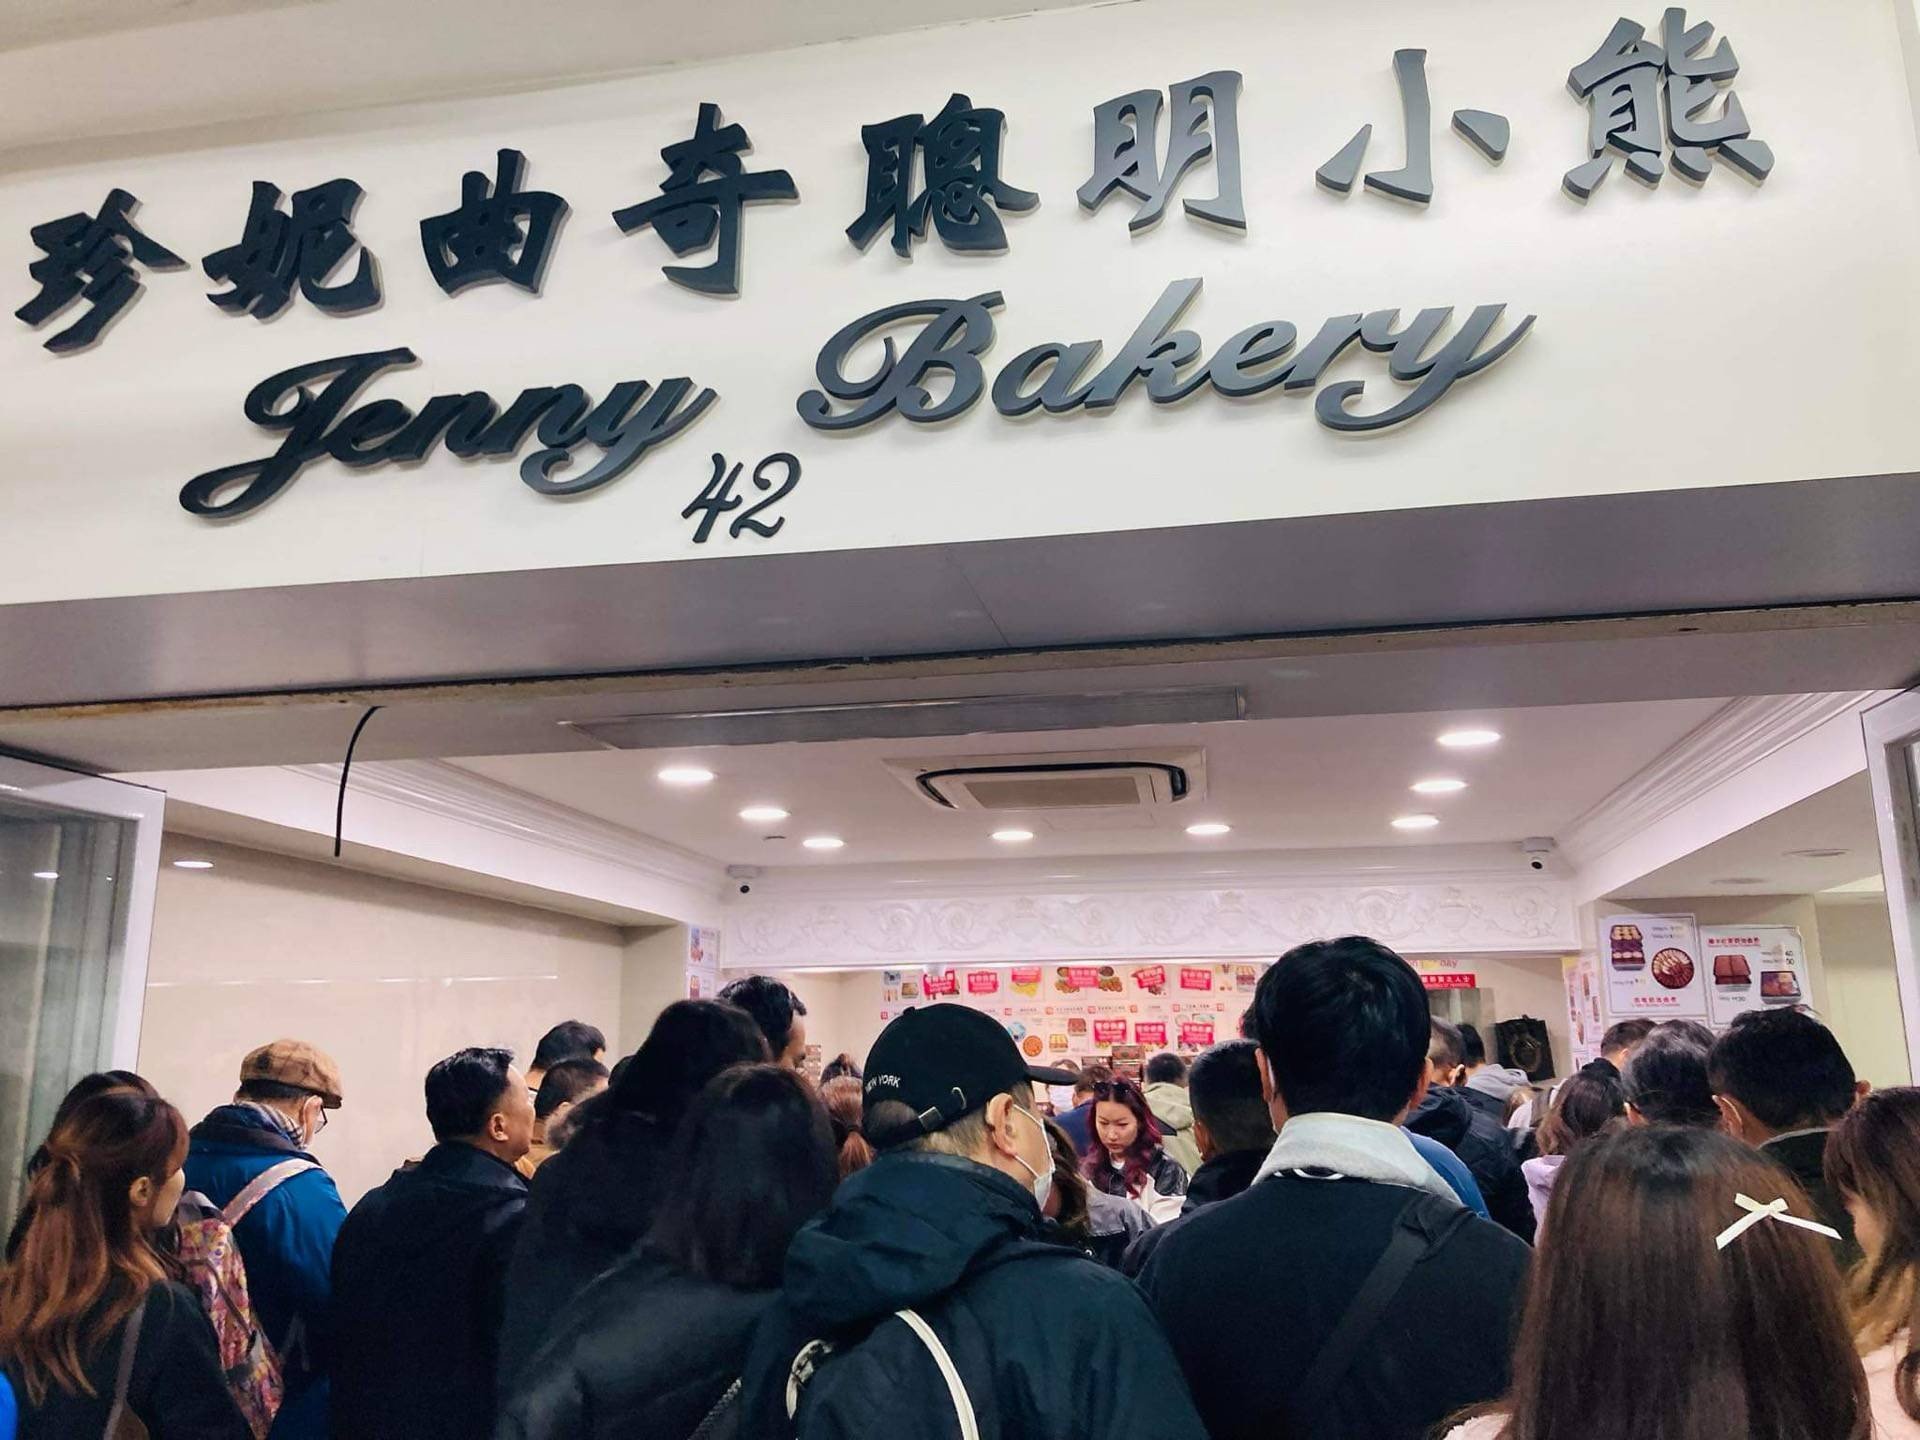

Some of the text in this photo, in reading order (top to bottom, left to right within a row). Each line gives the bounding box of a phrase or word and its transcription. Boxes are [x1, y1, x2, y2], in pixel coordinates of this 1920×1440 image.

[14, 7, 1775, 356] 珍妮曲奇聰明小熊
[179, 278, 1536, 521] Jenny Bakery
[680, 452, 802, 544] 42
[878, 1074, 901, 1089] YORK
